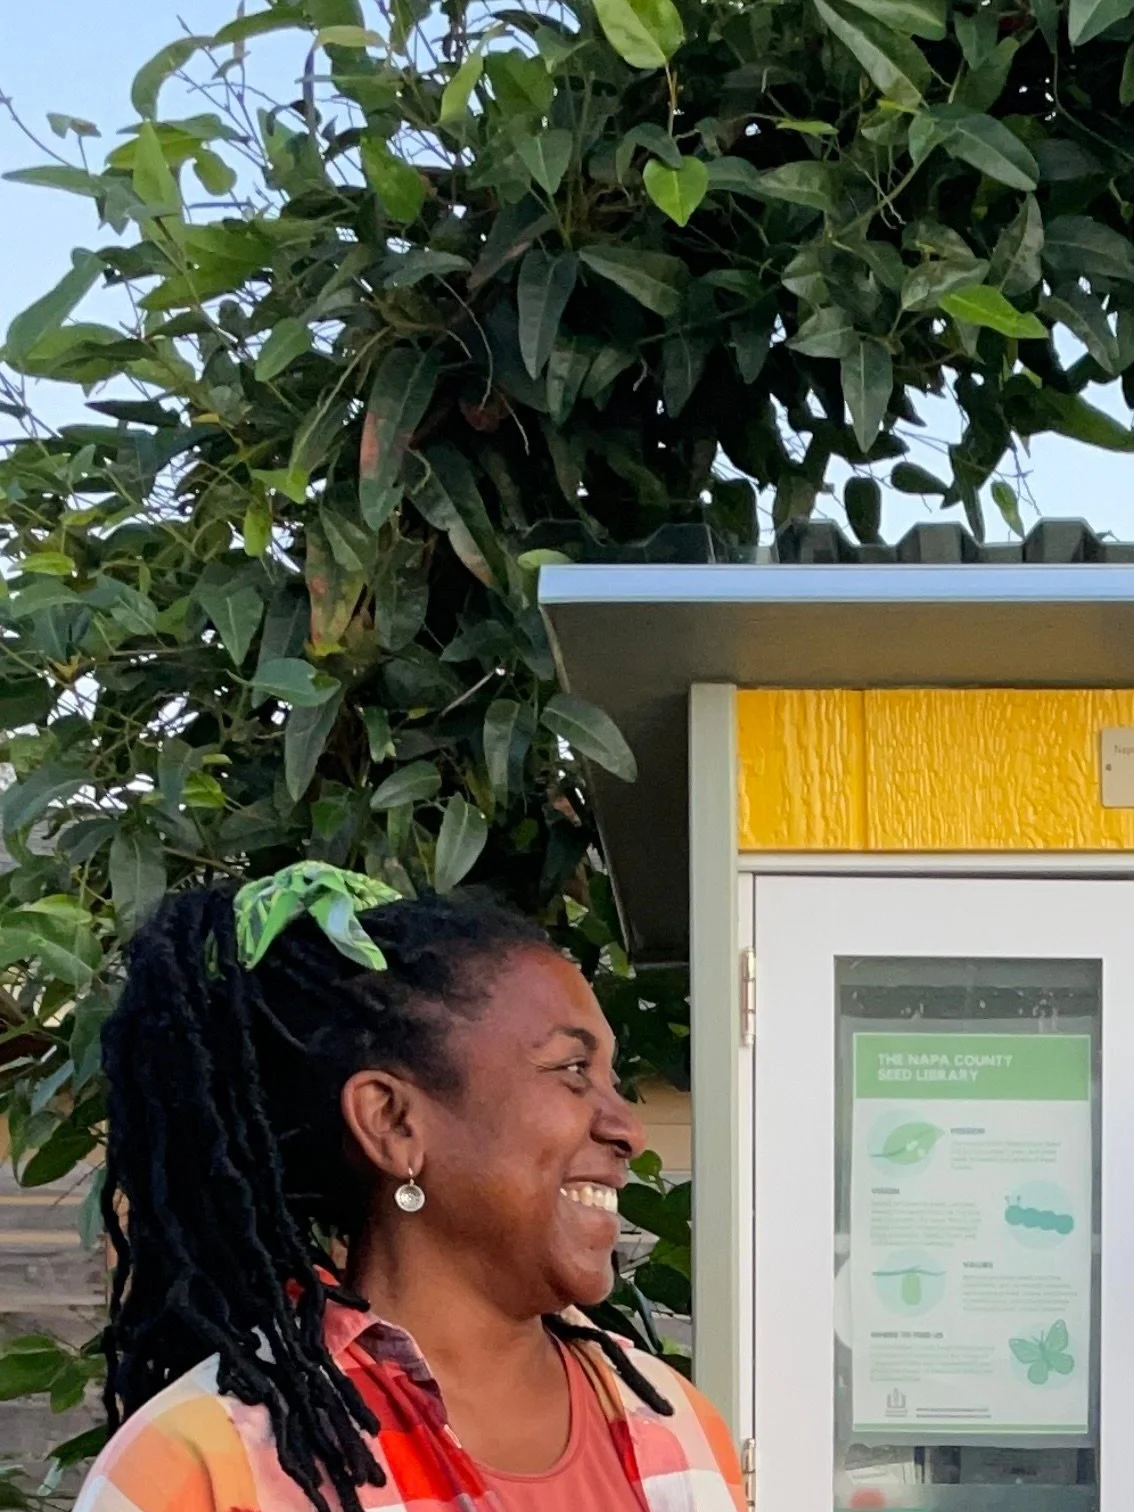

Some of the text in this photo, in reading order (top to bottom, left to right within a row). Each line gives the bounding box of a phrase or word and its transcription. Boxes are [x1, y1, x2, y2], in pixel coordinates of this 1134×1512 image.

[878, 1054, 1013, 1067] THE NAPA COUNTY
[878, 1069, 980, 1083] SEED LIBRARY
